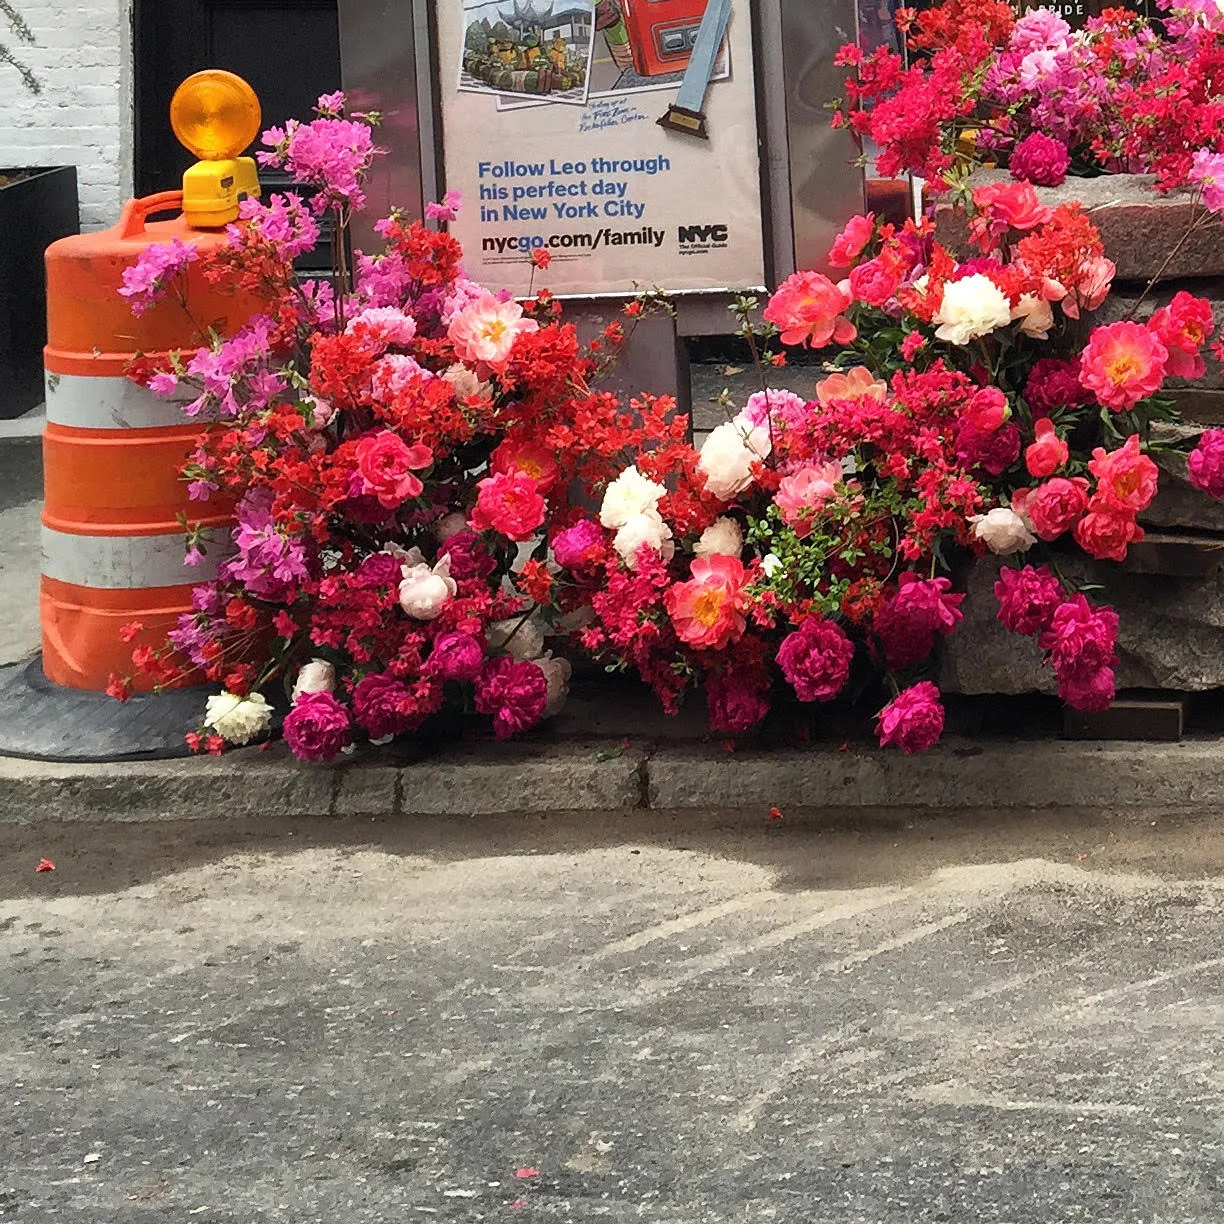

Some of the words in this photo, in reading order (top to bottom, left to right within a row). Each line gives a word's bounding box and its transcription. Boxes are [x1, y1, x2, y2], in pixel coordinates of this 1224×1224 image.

[478, 161, 545, 178] Follow
[549, 159, 586, 175] Leo
[590, 154, 671, 175] through
[479, 184, 508, 200] his
[512, 180, 587, 202] perfect
[592, 179, 628, 198] day
[480, 205, 498, 222] in
[503, 204, 547, 221] New
[553, 202, 599, 219] York
[604, 200, 646, 219] City
[482, 226, 665, 253] nycgo.com/family
[678, 224, 728, 242] NYC
